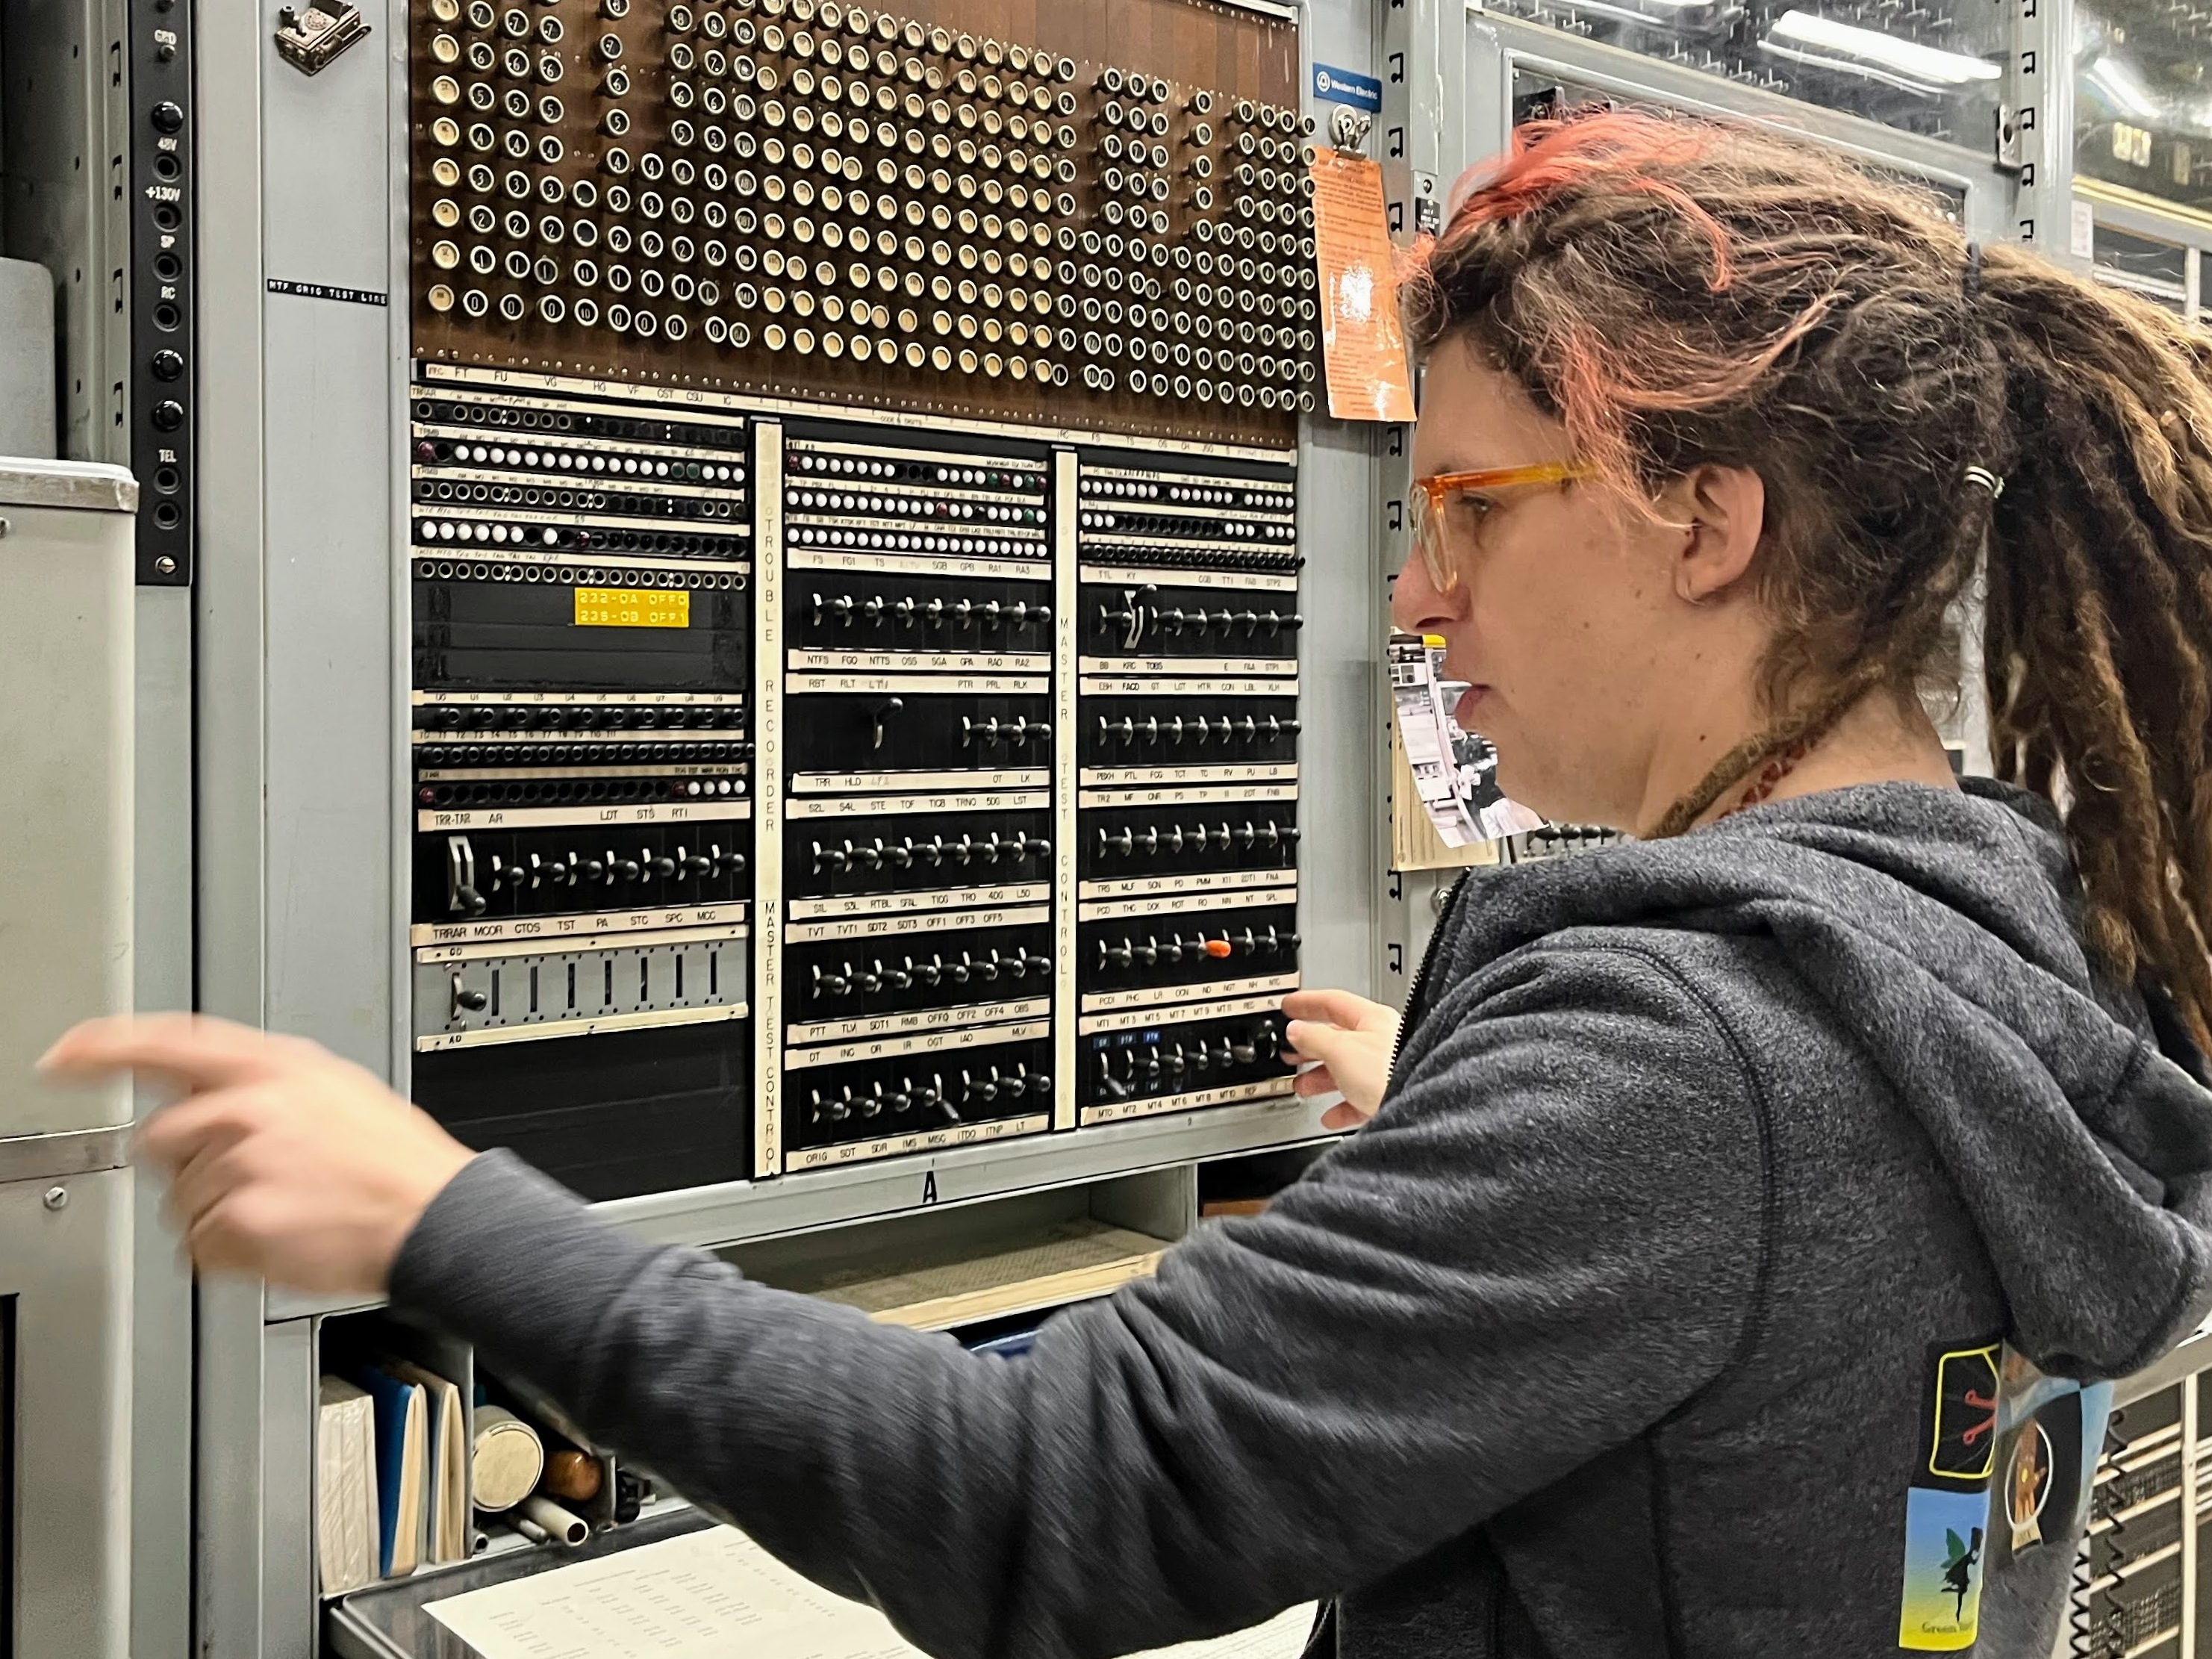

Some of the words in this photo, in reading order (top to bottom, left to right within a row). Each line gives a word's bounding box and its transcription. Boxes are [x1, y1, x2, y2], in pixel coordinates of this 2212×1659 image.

[1331, 80, 1356, 94] Western
[1356, 86, 1377, 100] Electric
[146, 186, 181, 202] +130V
[494, 371, 508, 382] FU
[159, 449, 177, 463] TEL
[765, 519, 773, 642] TROUBLE
[766, 680, 774, 831] RECORDER
[558, 920, 576, 930] TST
[596, 918, 608, 928] PA
[808, 927, 824, 937] TVT
[765, 902, 775, 985] MASTER
[766, 997, 775, 1059] TEST
[810, 1027, 826, 1037] PTT
[923, 1171, 937, 1204] A
